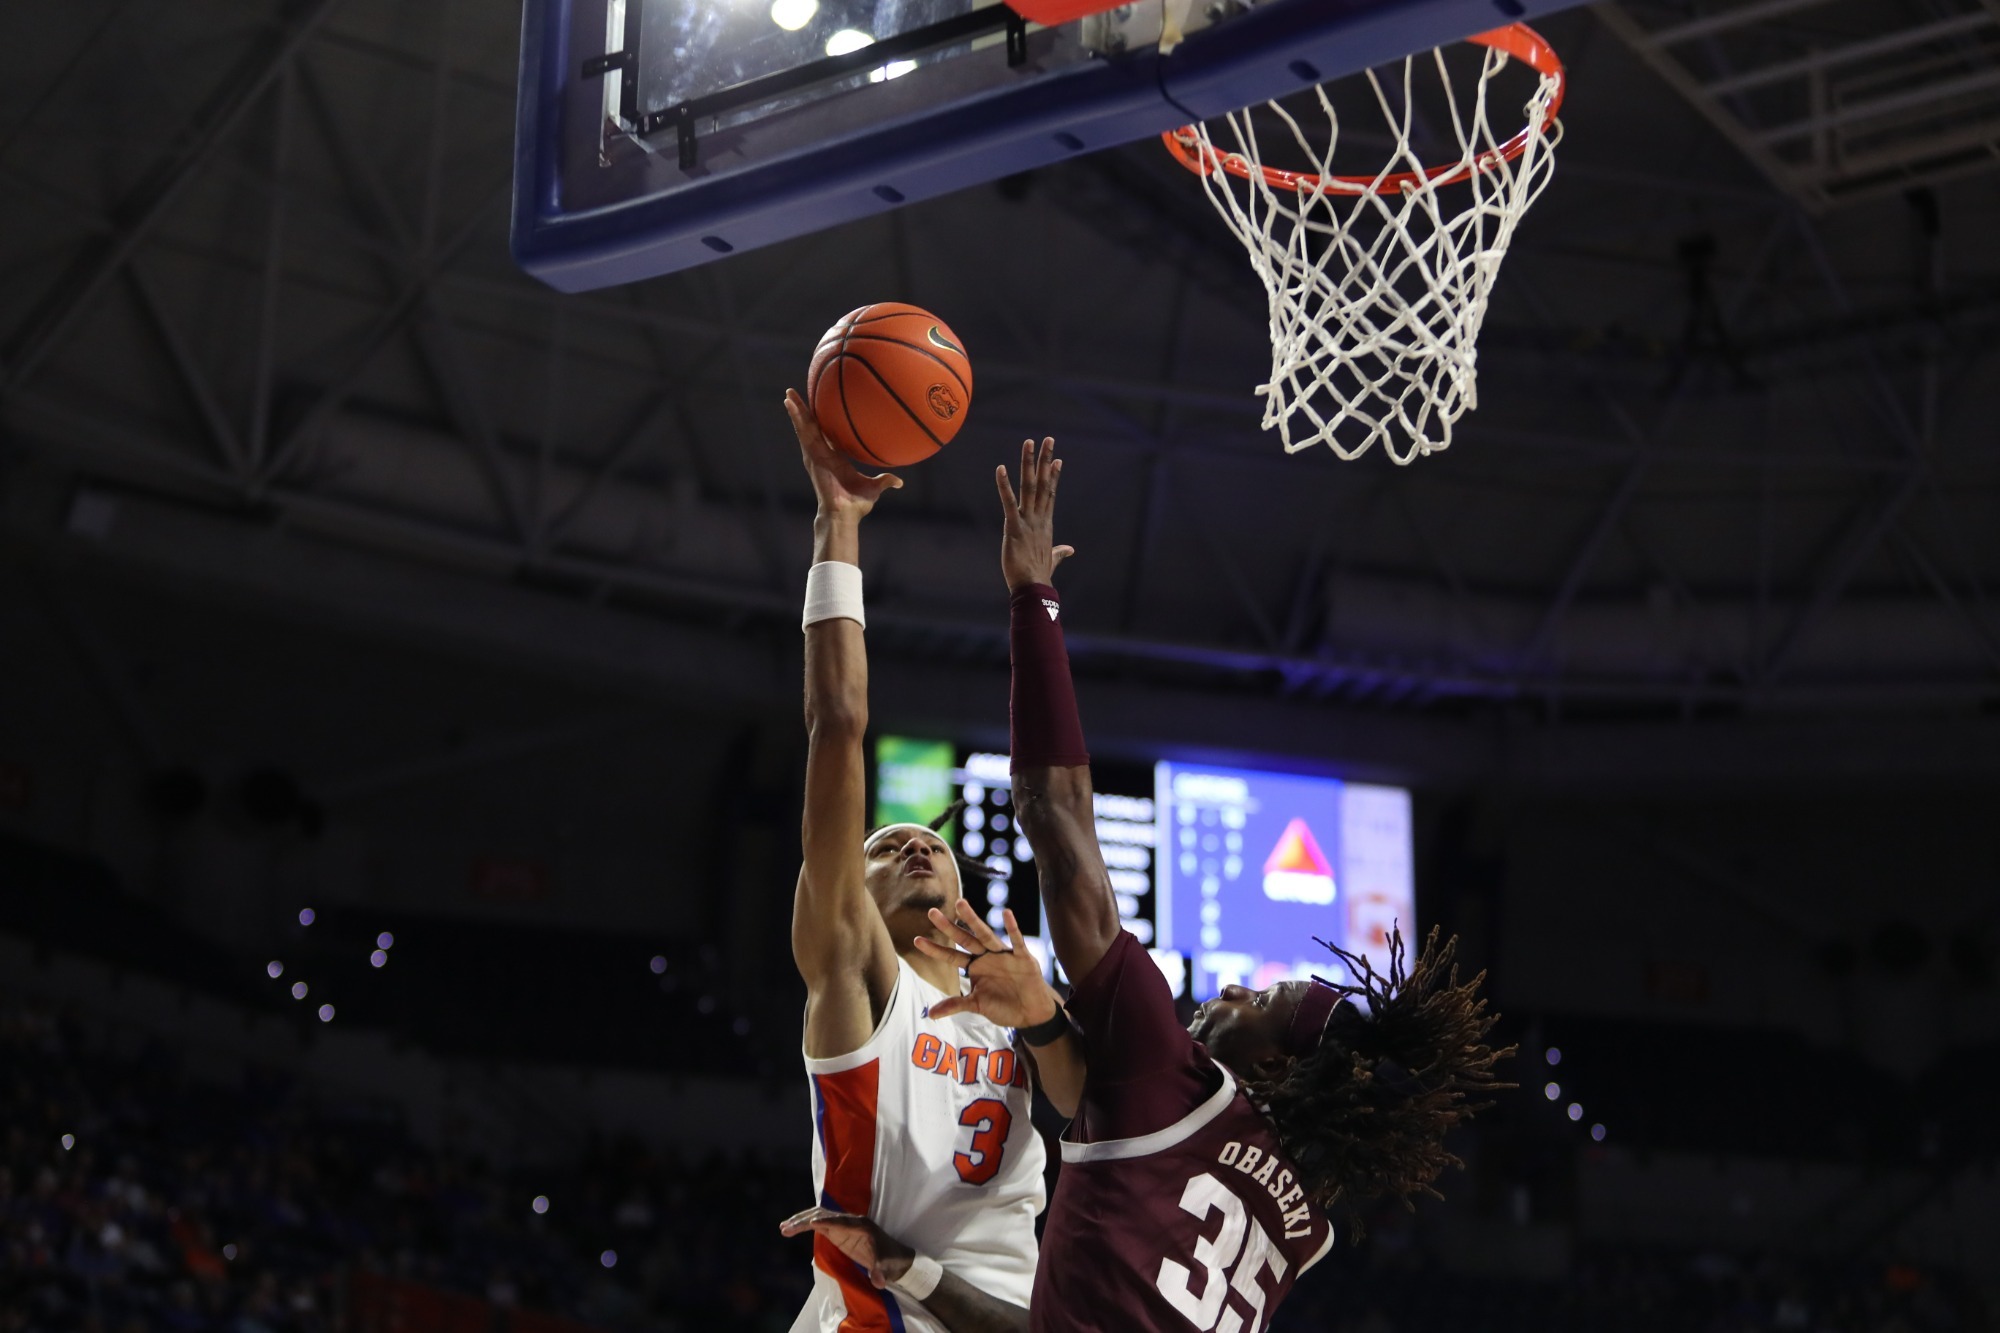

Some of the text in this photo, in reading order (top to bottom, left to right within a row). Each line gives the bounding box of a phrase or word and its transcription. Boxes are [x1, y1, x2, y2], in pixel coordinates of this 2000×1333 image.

[953, 1097, 1013, 1186] 3
[1217, 1141, 1312, 1240] OBASEKI
[1156, 1172, 1289, 1333] 35
